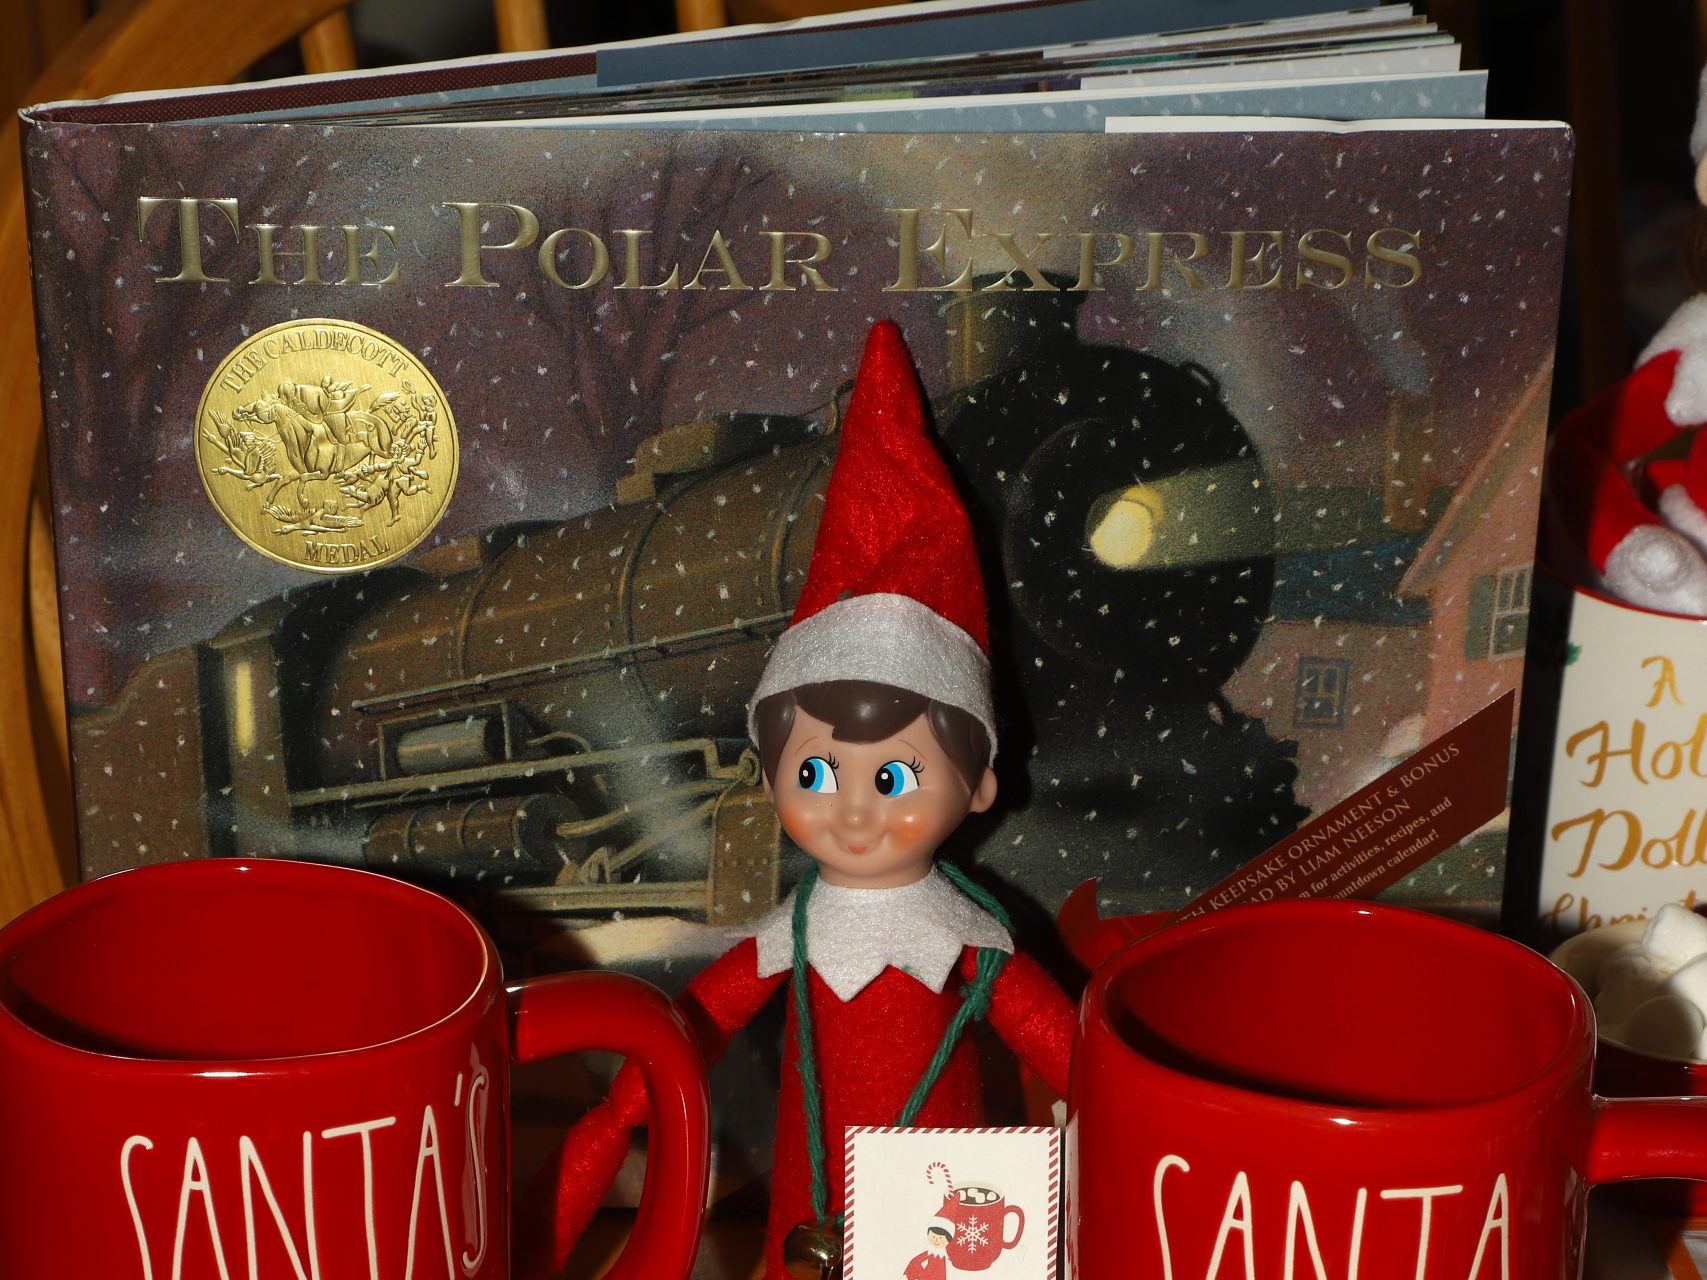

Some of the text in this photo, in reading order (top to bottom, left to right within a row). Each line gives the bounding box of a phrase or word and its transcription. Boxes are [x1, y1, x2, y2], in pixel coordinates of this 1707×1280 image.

[138, 196, 1422, 293] THE POLAR EXPRESS
[219, 328, 409, 394] THE CALDECOTT
[303, 534, 390, 565] MEDAL
[1641, 655, 1685, 708] A
[1209, 742, 1461, 911] KEEPSAKE ORNAMENT & BONUS
[1275, 870, 1296, 892] BY
[1299, 844, 1342, 877] LIAM
[1342, 798, 1412, 849] NEESON
[1310, 796, 1453, 893] for activities, recipes, and
[1328, 828, 1441, 899] ountdown calendar!
